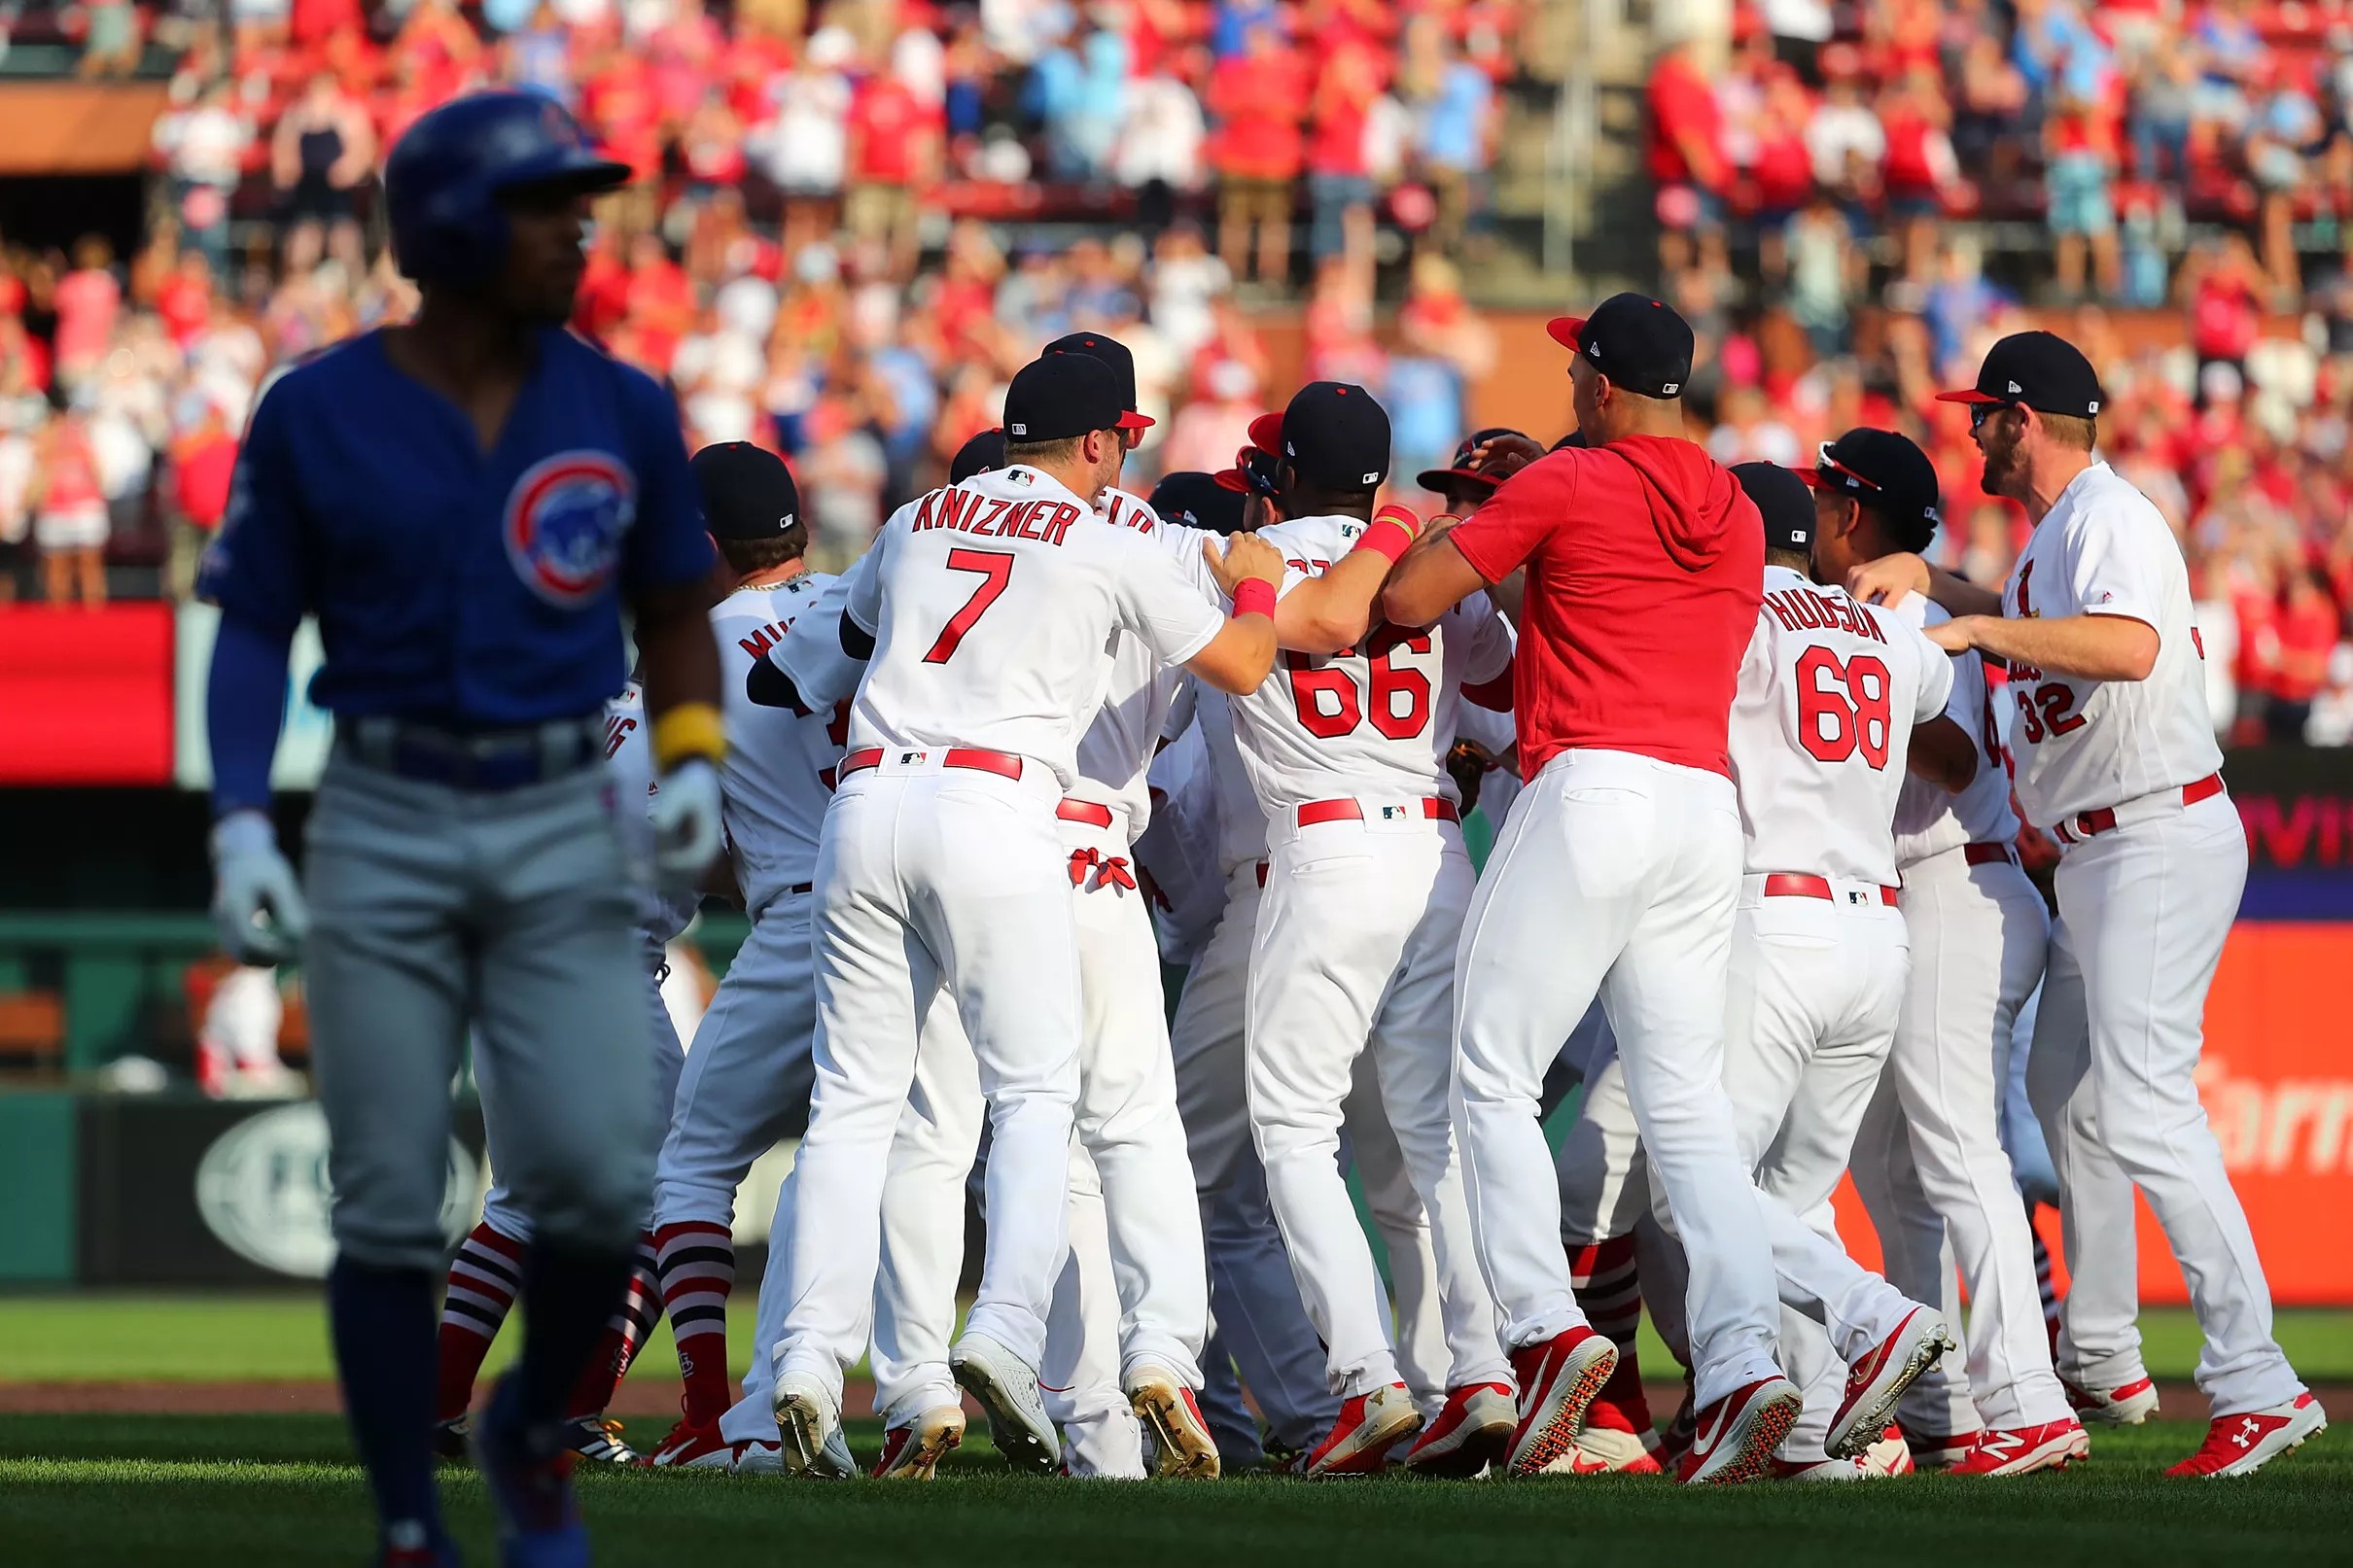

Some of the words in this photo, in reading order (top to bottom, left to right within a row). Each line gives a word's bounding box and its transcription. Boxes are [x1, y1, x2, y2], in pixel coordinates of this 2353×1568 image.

[912, 488, 1081, 546] KNIZNER
[922, 547, 1015, 665] 7
[1763, 588, 1888, 645] HUDSON
[1285, 620, 1431, 741] 66
[1795, 645, 1891, 771] 68
[2017, 681, 2088, 745] 32
